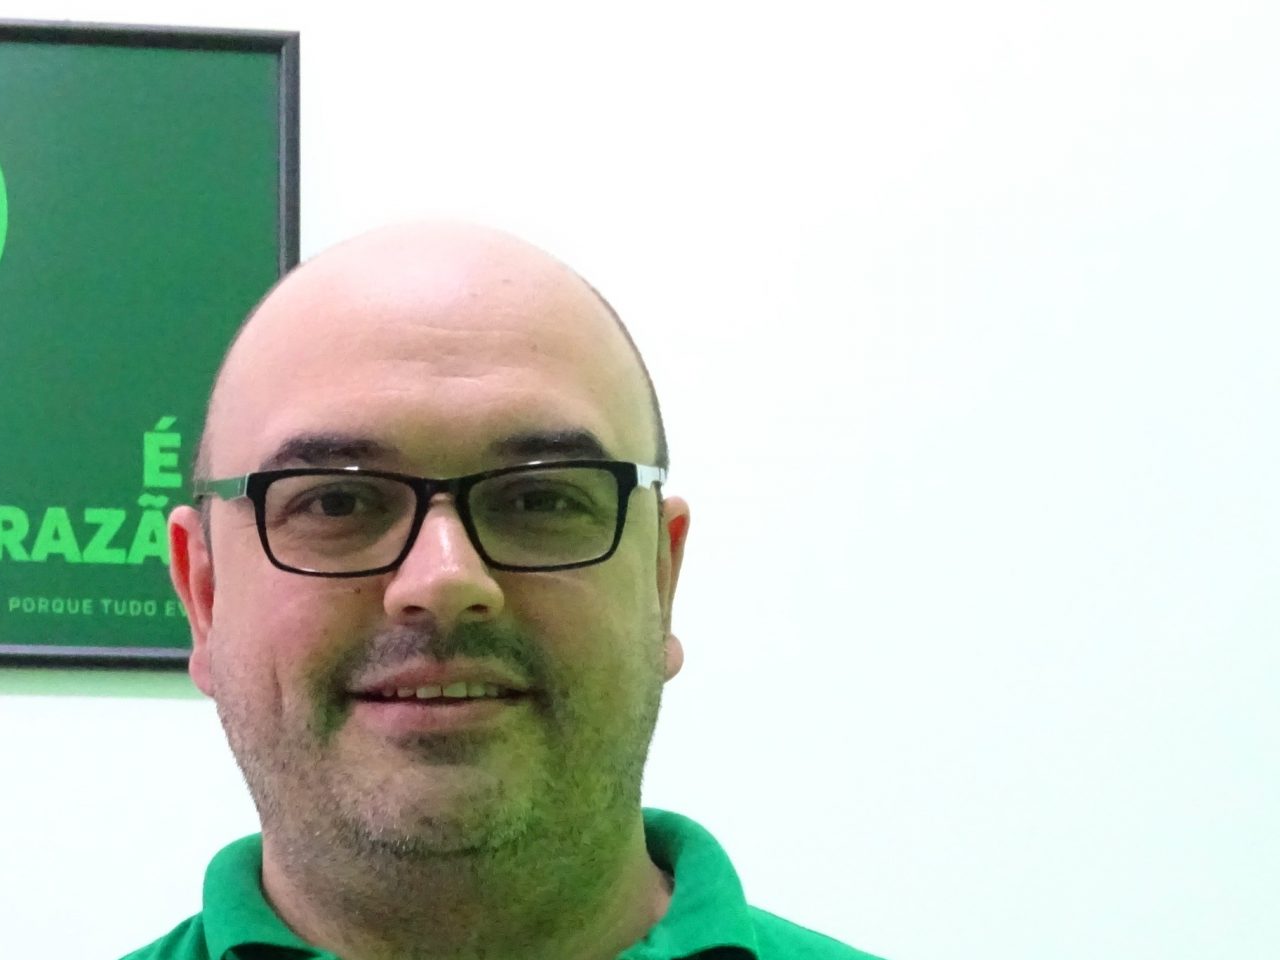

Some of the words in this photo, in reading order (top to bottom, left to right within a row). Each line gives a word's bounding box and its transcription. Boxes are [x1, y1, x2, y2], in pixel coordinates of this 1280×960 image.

[143, 416, 183, 488] É
[8, 596, 94, 615] PORQUE
[100, 598, 157, 617] TUDO
